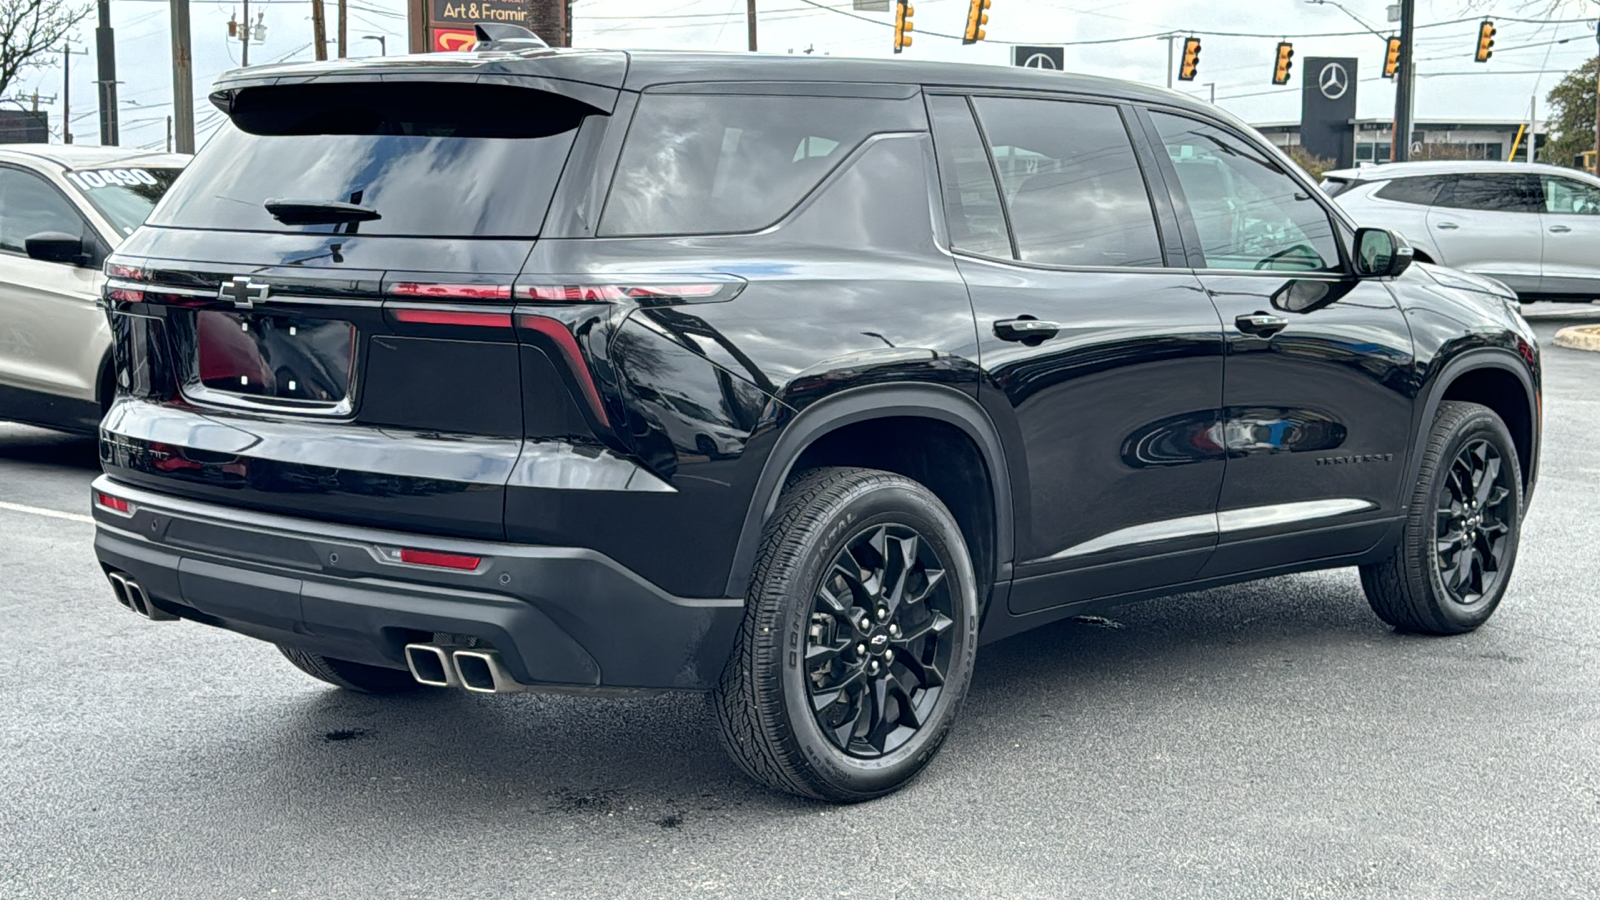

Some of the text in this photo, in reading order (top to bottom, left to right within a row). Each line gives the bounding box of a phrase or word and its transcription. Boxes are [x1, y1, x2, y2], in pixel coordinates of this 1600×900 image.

[443, 2, 466, 18] Art
[468, 3, 480, 19] &
[67, 168, 158, 191] 10490
